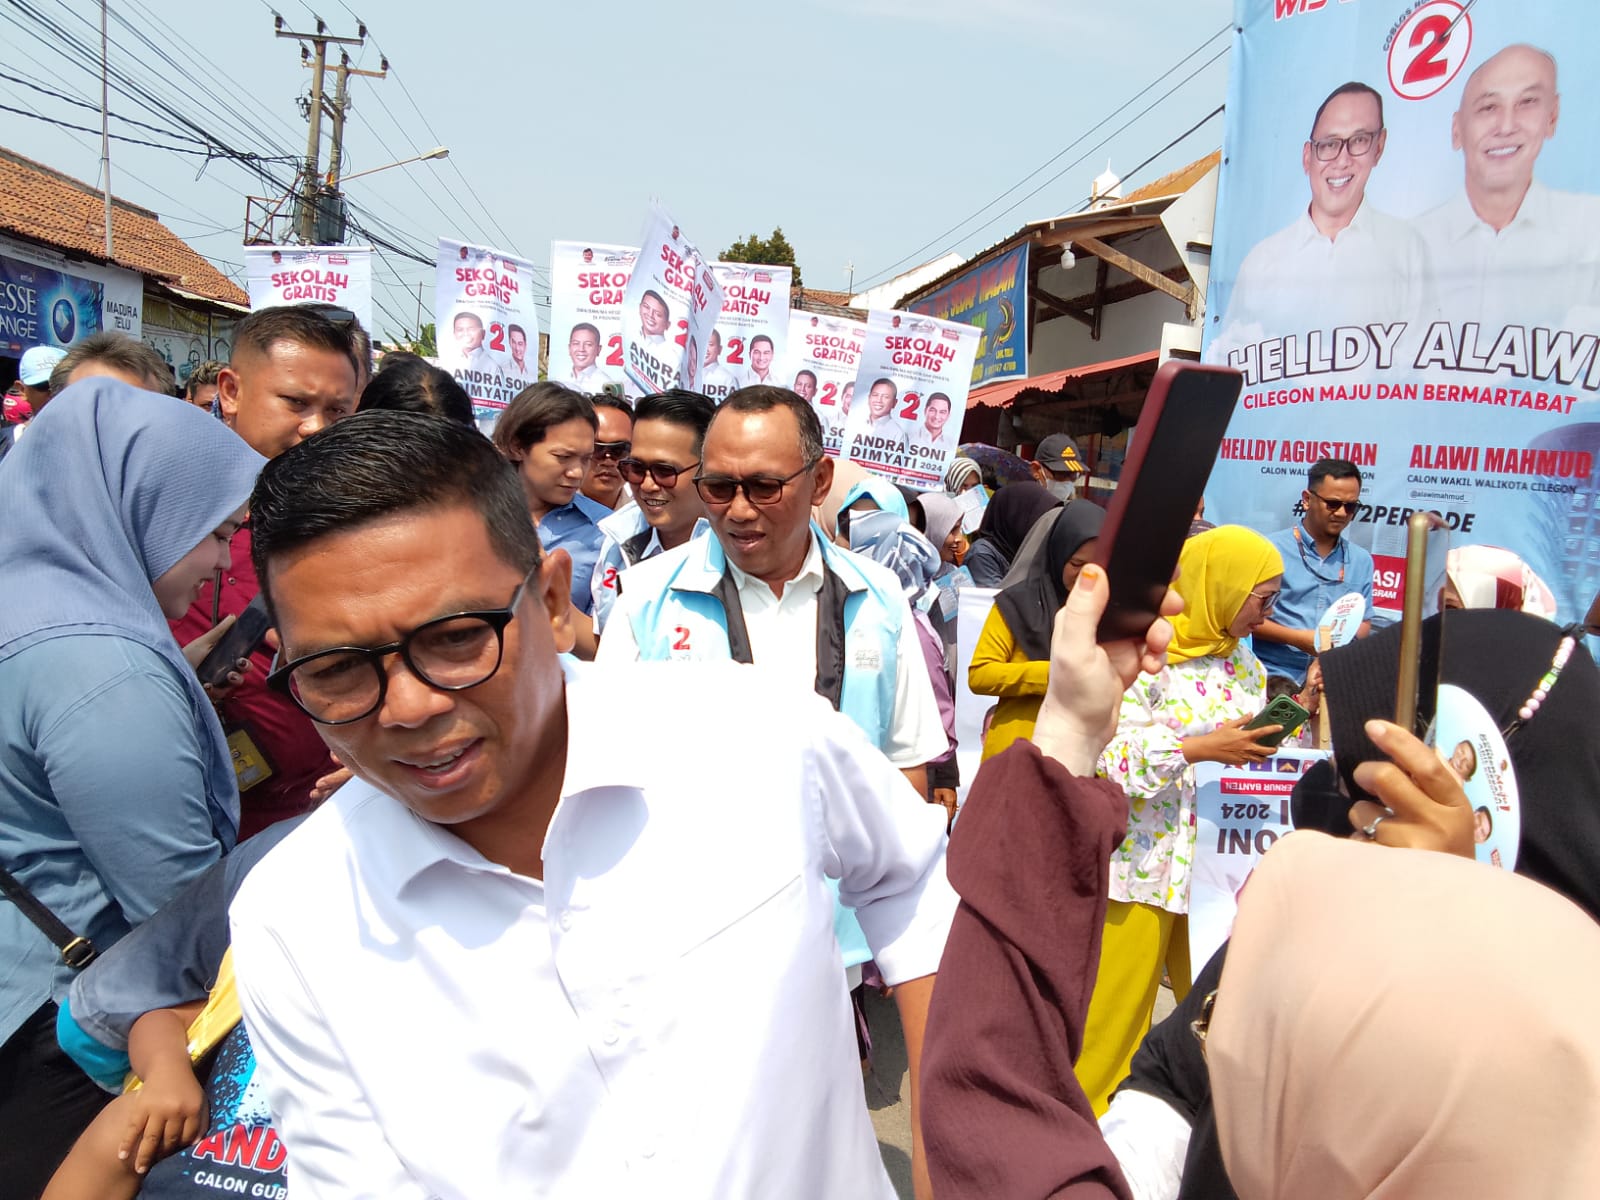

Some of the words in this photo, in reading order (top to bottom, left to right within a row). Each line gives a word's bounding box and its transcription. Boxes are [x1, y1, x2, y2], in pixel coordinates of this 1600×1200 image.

[1402, 14, 1452, 85] 2
[271, 269, 349, 289] SEKOLAH
[456, 267, 519, 294] SEKOLAH
[577, 272, 632, 289] SEKO
[283, 285, 337, 302] GRATIS
[465, 283, 511, 304] GRATIS
[589, 289, 625, 306] GRA
[490, 323, 505, 352] 2
[885, 335, 956, 362] SEKOLAH
[606, 335, 624, 367] 2
[726, 338, 744, 365] 2
[813, 347, 855, 365] GRATIS
[892, 351, 943, 372] GRATIS
[1228, 322, 1408, 386] HELLDY
[1413, 321, 1600, 391] ALAWI
[454, 368, 502, 387] ANDRA
[820, 382, 838, 406] 2
[1243, 387, 1314, 410] CILEGON
[1320, 384, 1371, 401] MAJU
[1376, 384, 1418, 401] DAN
[1423, 384, 1578, 414] BERMARTABAT
[900, 393, 920, 420] 2
[850, 446, 917, 469] DIMYATI
[920, 462, 942, 472] 2024
[853, 433, 905, 454] ANDRA
[909, 444, 947, 462] SONI
[1221, 438, 1277, 462] HELLDY
[1280, 440, 1378, 466] AGUSTIAN
[1261, 466, 1287, 475] CALON
[1409, 444, 1480, 471] ALAWI
[1484, 447, 1593, 478] MAHMUD
[1407, 475, 1437, 484] CALON
[1440, 476, 1472, 487] WAKIL
[1475, 479, 1528, 490] WALIKOTA
[1531, 483, 1577, 494] CILEGON
[602, 569, 617, 589] 2
[673, 626, 690, 650] 2
[1225, 782, 1262, 791] BANTEN
[1221, 803, 1270, 820] 2024
[192, 1123, 288, 1176] AND
[194, 1170, 248, 1194] CALON
